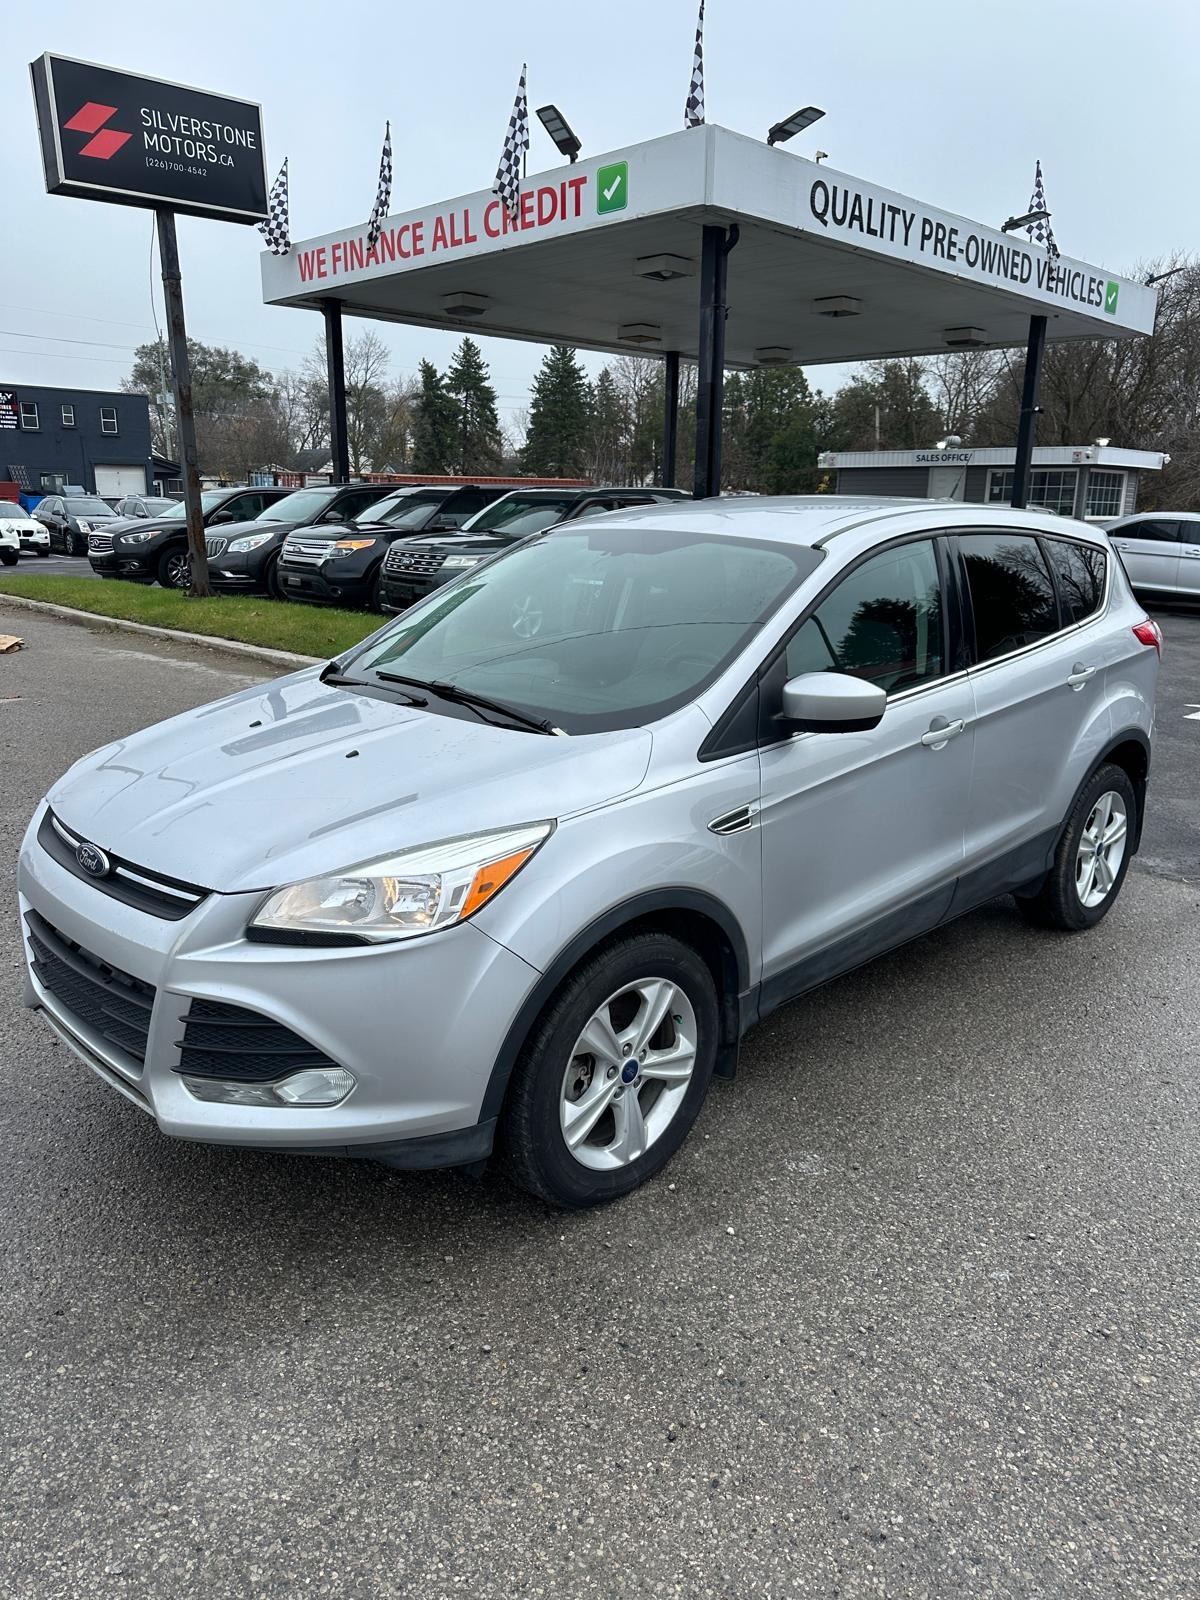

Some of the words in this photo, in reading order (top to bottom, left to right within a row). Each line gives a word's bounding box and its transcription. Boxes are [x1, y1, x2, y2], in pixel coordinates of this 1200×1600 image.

[140, 107, 256, 149] SILVERSTONE
[143, 131, 235, 167] MOTORS.CA
[145, 156, 207, 176] (226)700-4542
[297, 247, 328, 282] WE
[331, 221, 425, 275] FINANCE
[431, 208, 478, 252] ALL
[483, 175, 588, 238] CREDIT
[809, 179, 916, 247] QUALITY
[920, 217, 1032, 284] PRE-OWNED
[916, 454, 940, 462] SALES
[941, 453, 969, 462] OFFICE
